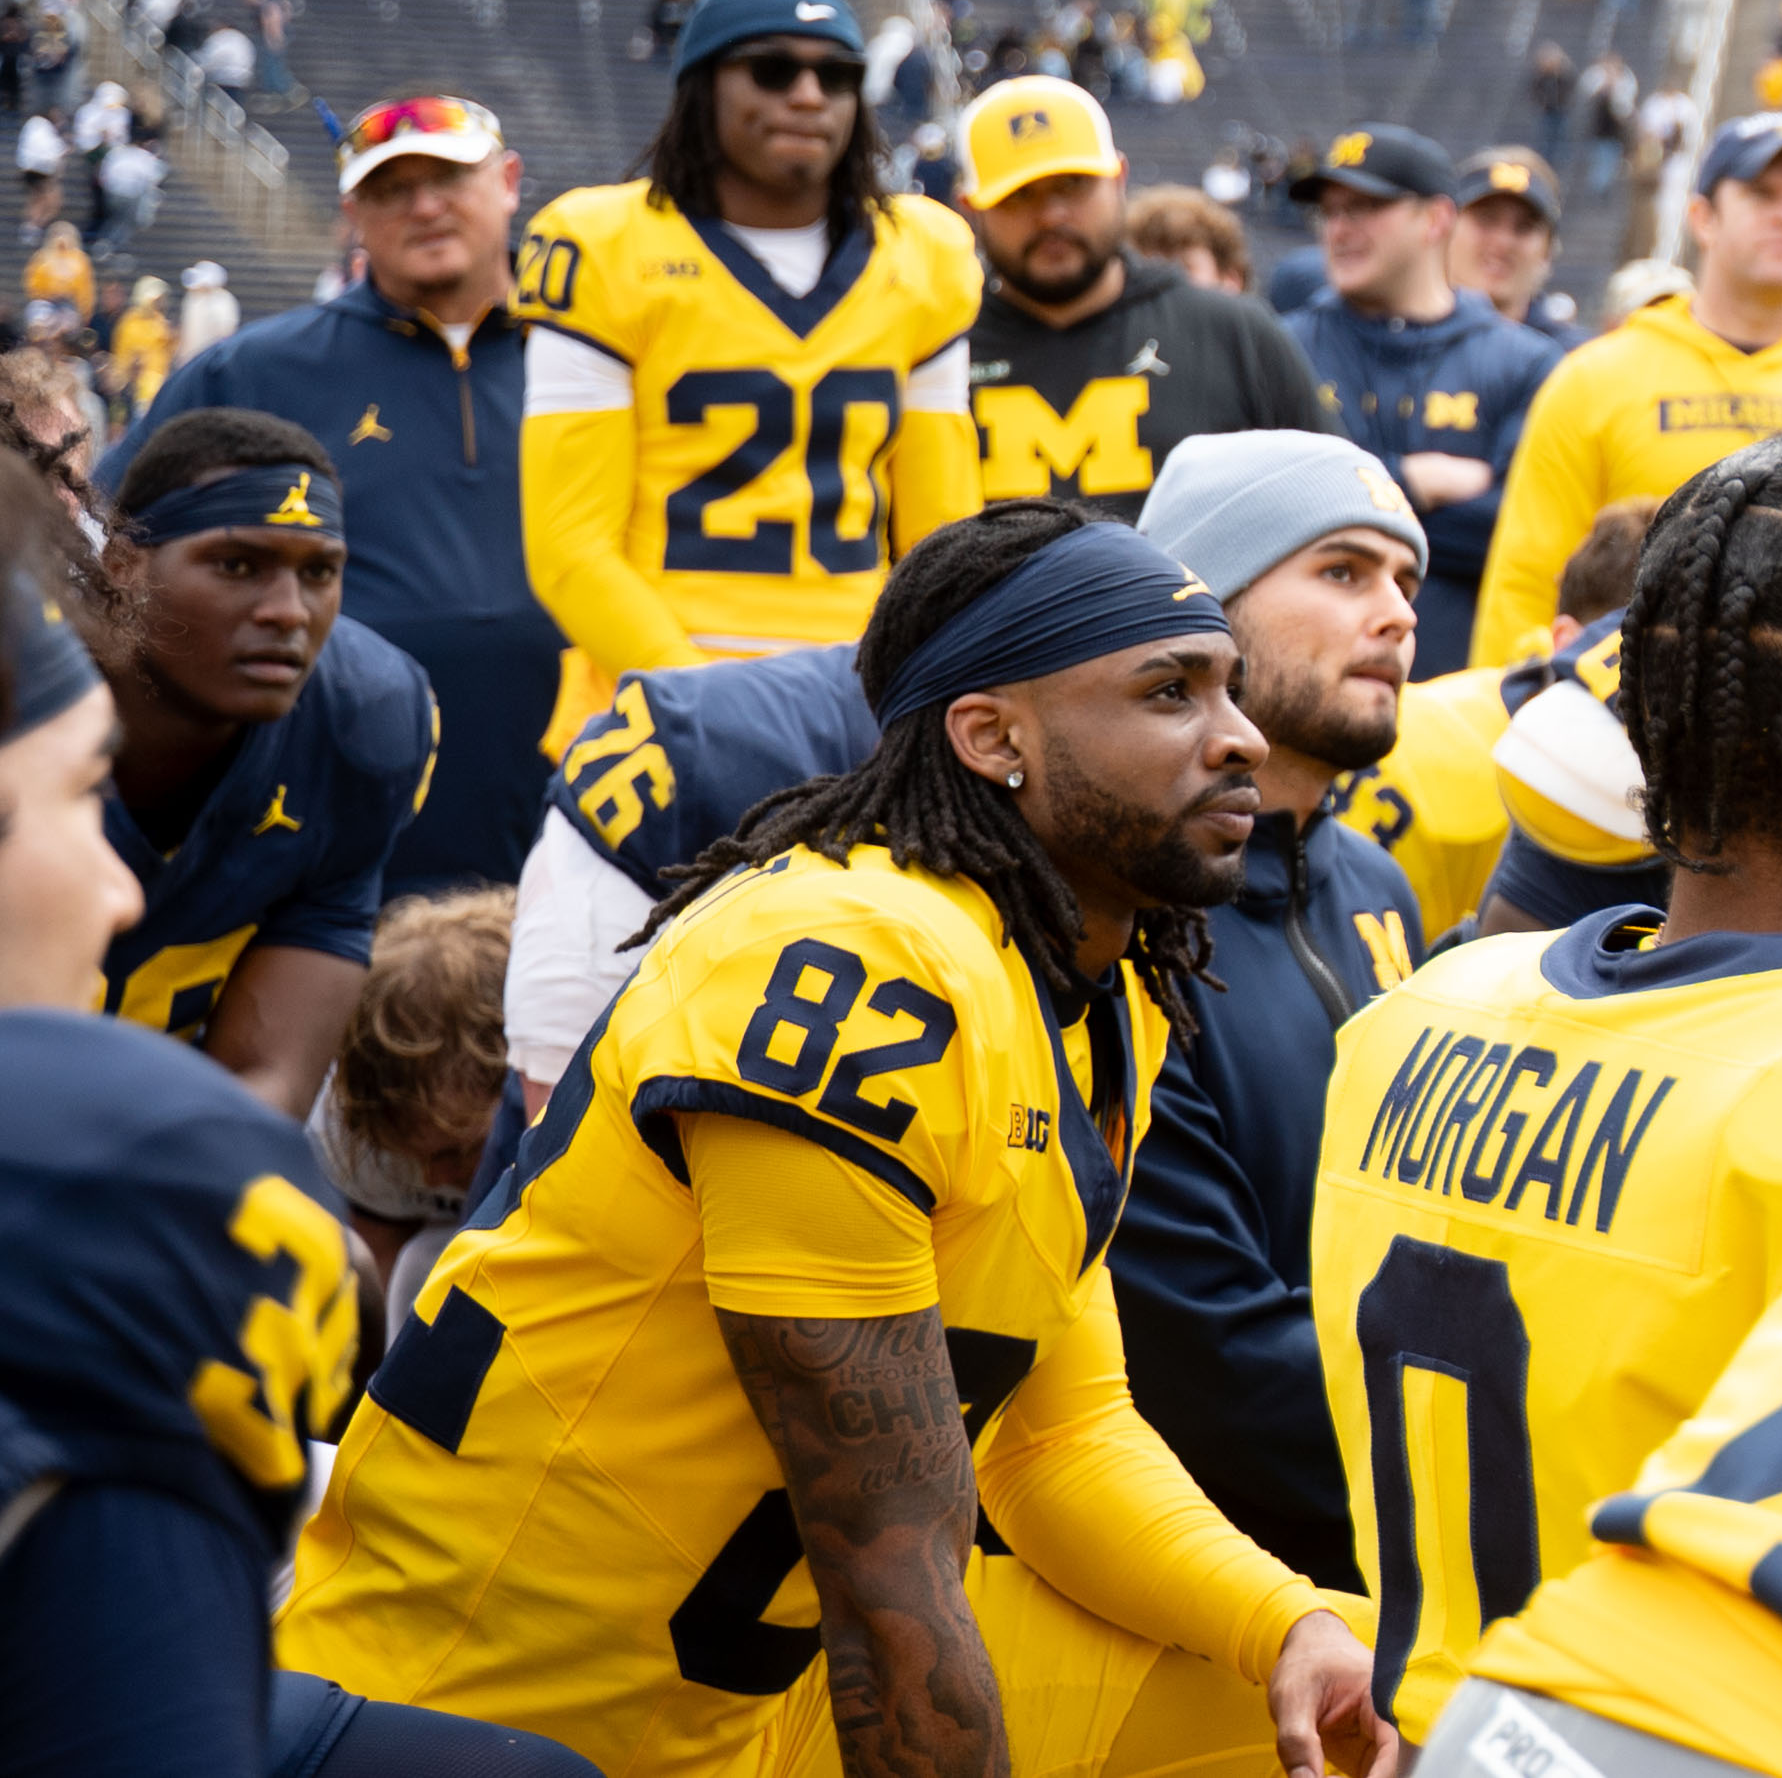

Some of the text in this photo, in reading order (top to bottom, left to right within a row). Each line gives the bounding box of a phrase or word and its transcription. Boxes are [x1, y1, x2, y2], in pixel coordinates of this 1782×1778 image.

[662, 367, 901, 576] 20
[973, 374, 1154, 501] M
[563, 679, 677, 853] 76
[737, 936, 957, 1144] 82
[1359, 1026, 1678, 1235] MORGAN
[1356, 1233, 1542, 1725] 0
